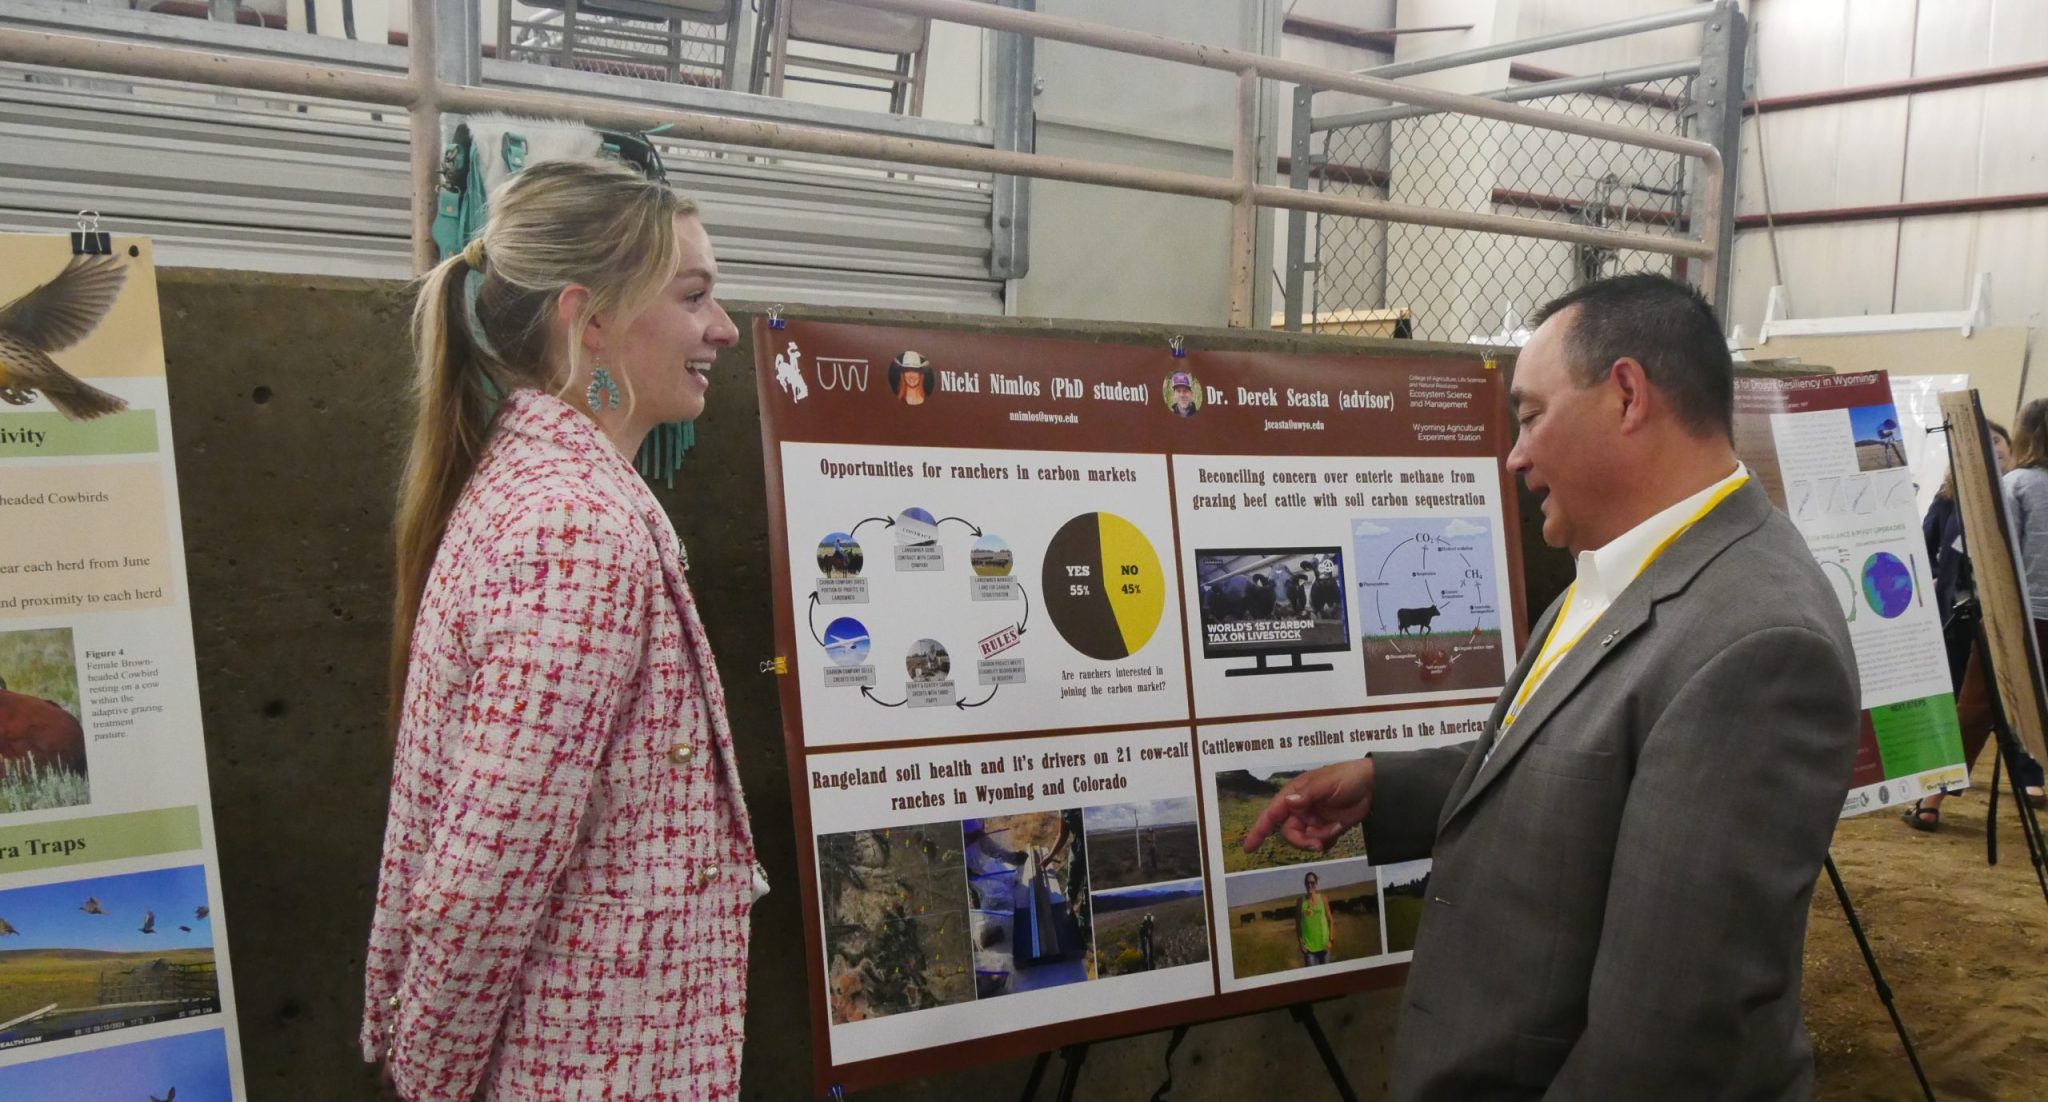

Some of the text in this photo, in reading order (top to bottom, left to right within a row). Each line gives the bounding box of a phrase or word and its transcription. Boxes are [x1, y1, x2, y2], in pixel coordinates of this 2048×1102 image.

[940, 371, 1149, 406] Nicki Nimlos (PhD student)
[1779, 379, 1821, 390] Resiliency
[1823, 378, 1832, 386] in
[1206, 386, 1394, 412] Dr. Derek Scasta (advisor)
[1410, 390, 1472, 399] Ecosystem Science
[1425, 401, 1468, 409] Management
[1009, 411, 1079, 424] nnimlos@uwyo.edu
[1413, 424, 1484, 432] Wyoming Agricultural
[1418, 433, 1482, 442] Experiment Station
[821, 459, 1137, 482] Opportunities for ranchers in carbon markets
[1199, 469, 1475, 487] Reconciling concern over enteric methane from
[48, 492, 110, 504] Cowbirds
[1193, 492, 1486, 510] grazing beef cattle with soil carbon sequestration
[24, 562, 53, 573] each
[56, 559, 85, 571] herd
[89, 558, 119, 569] from
[123, 557, 151, 568] June
[1121, 565, 1139, 576] NO
[1066, 566, 1090, 577] YES
[1070, 585, 1090, 596] 55%
[1121, 584, 1142, 594] 45%
[21, 594, 83, 610] proximity
[88, 593, 100, 603] to
[104, 590, 132, 602] each
[136, 587, 162, 600] herd
[1207, 620, 1315, 633] WORLD'S 1ST CARBON
[1208, 630, 1301, 642] TAX ON LIVESTOCK
[982, 631, 1018, 656] RULES
[86, 650, 116, 659] Figure
[87, 662, 118, 670] Female
[88, 668, 159, 682] headed Cowbird
[1062, 666, 1164, 681] Are ranchers interested in
[89, 686, 119, 694] resting
[1061, 681, 1166, 699] joining the carbon market?
[91, 697, 119, 705] within
[92, 708, 129, 718] adaptive
[93, 719, 134, 728] treatment
[1202, 739, 1275, 756] Cattlewomen
[1280, 738, 1293, 749] as
[1298, 730, 1345, 747] resilient
[1350, 725, 1397, 744] stewards
[1403, 724, 1414, 739] in
[1418, 722, 1435, 737] the
[812, 742, 1189, 790] Rangeland soil health and it's drivers on 21 cow-calf
[891, 775, 1127, 812] ranches in Wyoming and Colorado
[25, 838, 86, 856] Traps
